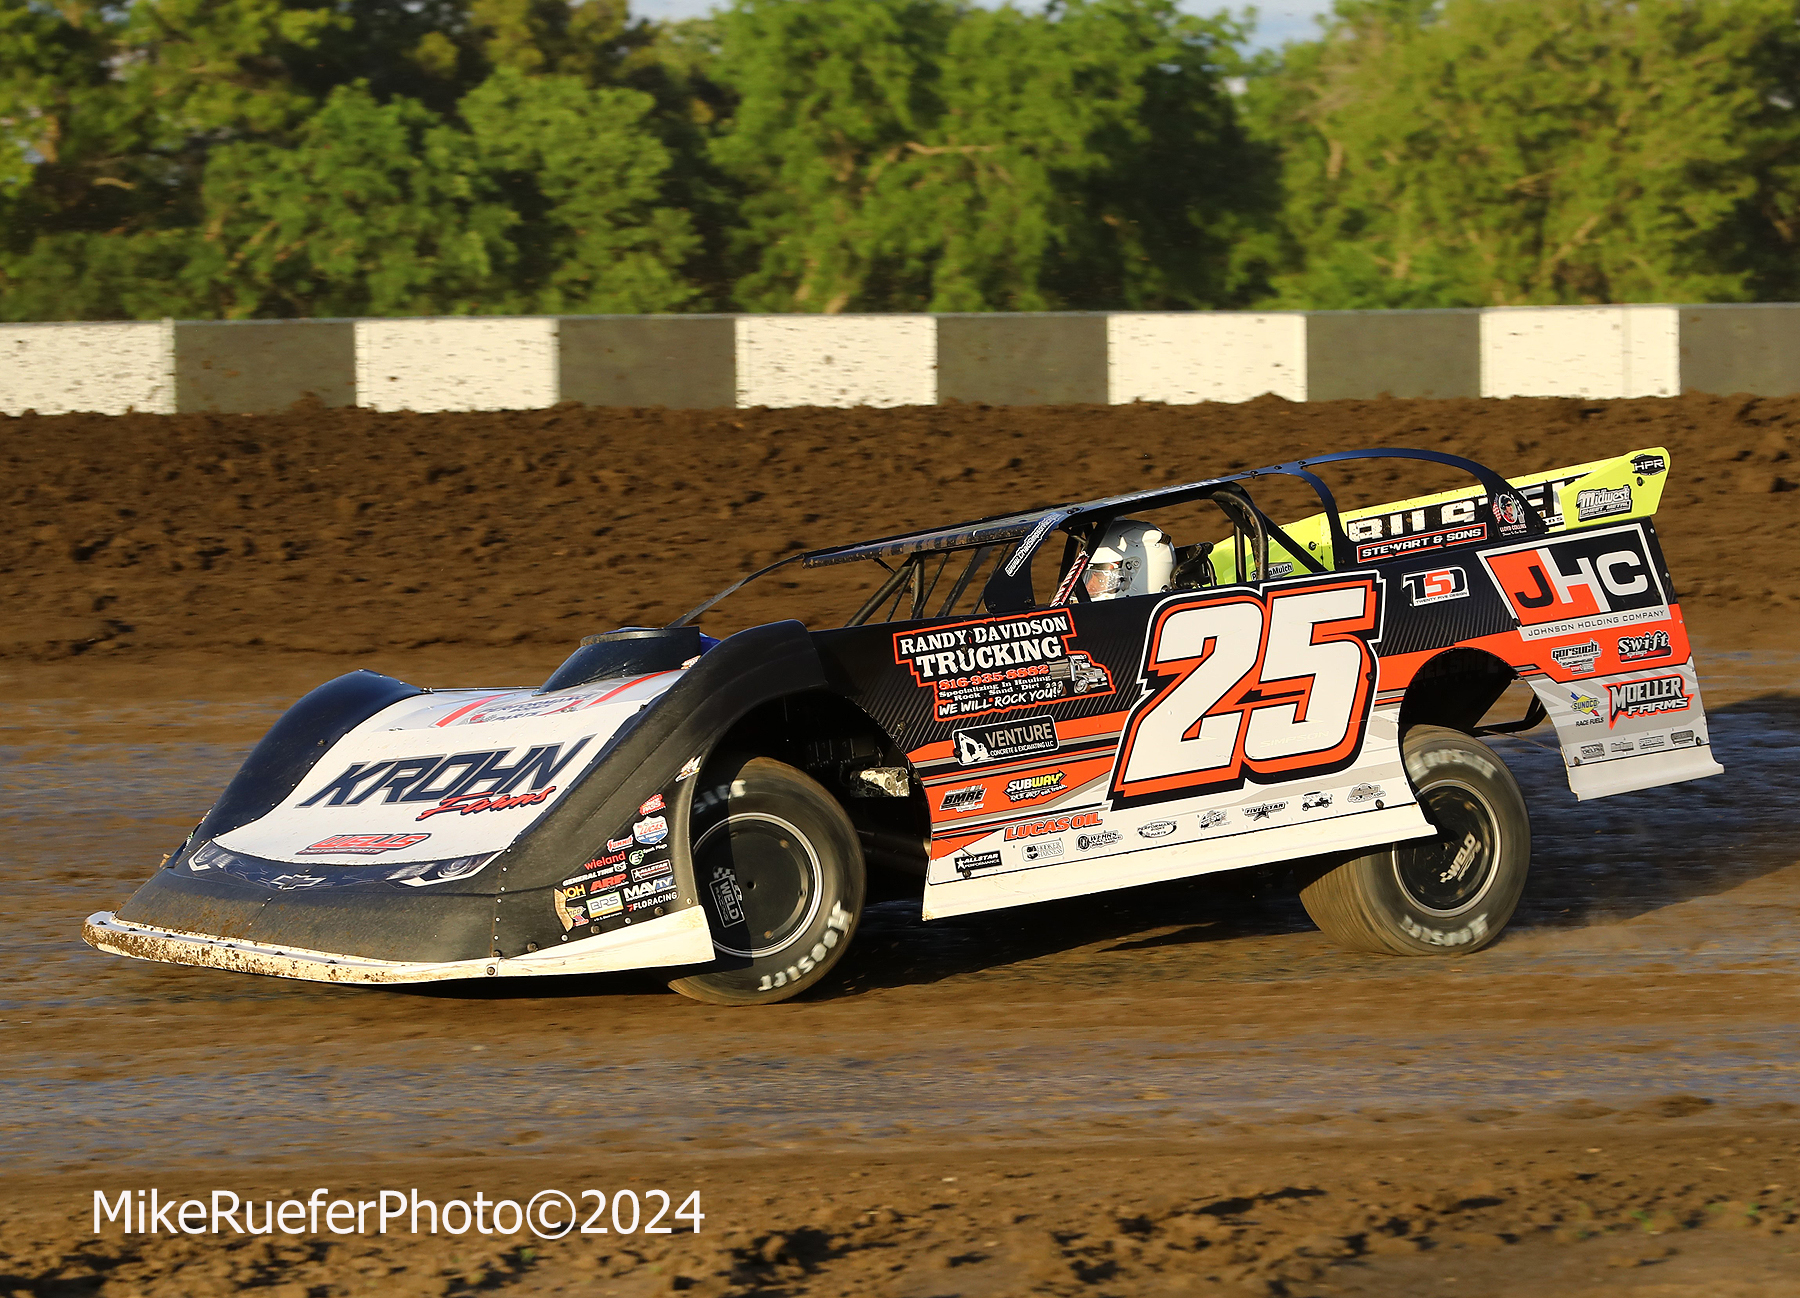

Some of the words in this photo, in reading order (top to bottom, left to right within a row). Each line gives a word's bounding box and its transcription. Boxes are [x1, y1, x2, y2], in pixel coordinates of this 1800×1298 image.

[1634, 459, 1664, 471] HPR
[1578, 486, 1630, 508] Midwest
[1362, 539, 1430, 557] STEWART
[1433, 535, 1444, 544] &
[1446, 528, 1482, 542] SONS
[1514, 548, 1649, 613] JHC
[1527, 624, 1575, 638] JOHNSON
[1577, 616, 1620, 630] HOLDING
[1622, 609, 1666, 623] COMPANY
[900, 629, 967, 655] RANDY
[972, 616, 1069, 644] DAVIDSON
[1617, 631, 1670, 654] Swift
[915, 636, 1062, 678] TRUCKING
[954, 692, 981, 702] Rock
[1021, 682, 1040, 691] Dirt
[1116, 580, 1376, 796] 25
[1609, 675, 1683, 718] MOELLER
[938, 704, 958, 716] WE
[960, 699, 993, 713] WILL
[994, 693, 1027, 708] ROCK
[1573, 699, 1598, 710] SUNOCO
[1627, 697, 1689, 716] FARMS
[1575, 719, 1589, 727] RACE
[1589, 717, 1605, 725] FUELS
[985, 723, 1053, 748] VENTURE
[293, 733, 598, 809] KROHN
[1007, 772, 1064, 792] SUBWAY
[415, 786, 557, 821] Farms
[1003, 815, 1071, 842] LUCAS
[1071, 811, 1103, 830] OIL
[310, 833, 432, 850] WELLS
[584, 850, 627, 871] wieland
[964, 854, 999, 863] ALLSTAR
[1447, 831, 1476, 877] WELD
[562, 871, 597, 887] GENERAL
[590, 873, 628, 892] ARP
[623, 876, 674, 899] MAVTV
[633, 891, 678, 911] FLORACING
[719, 880, 740, 920] WELD
